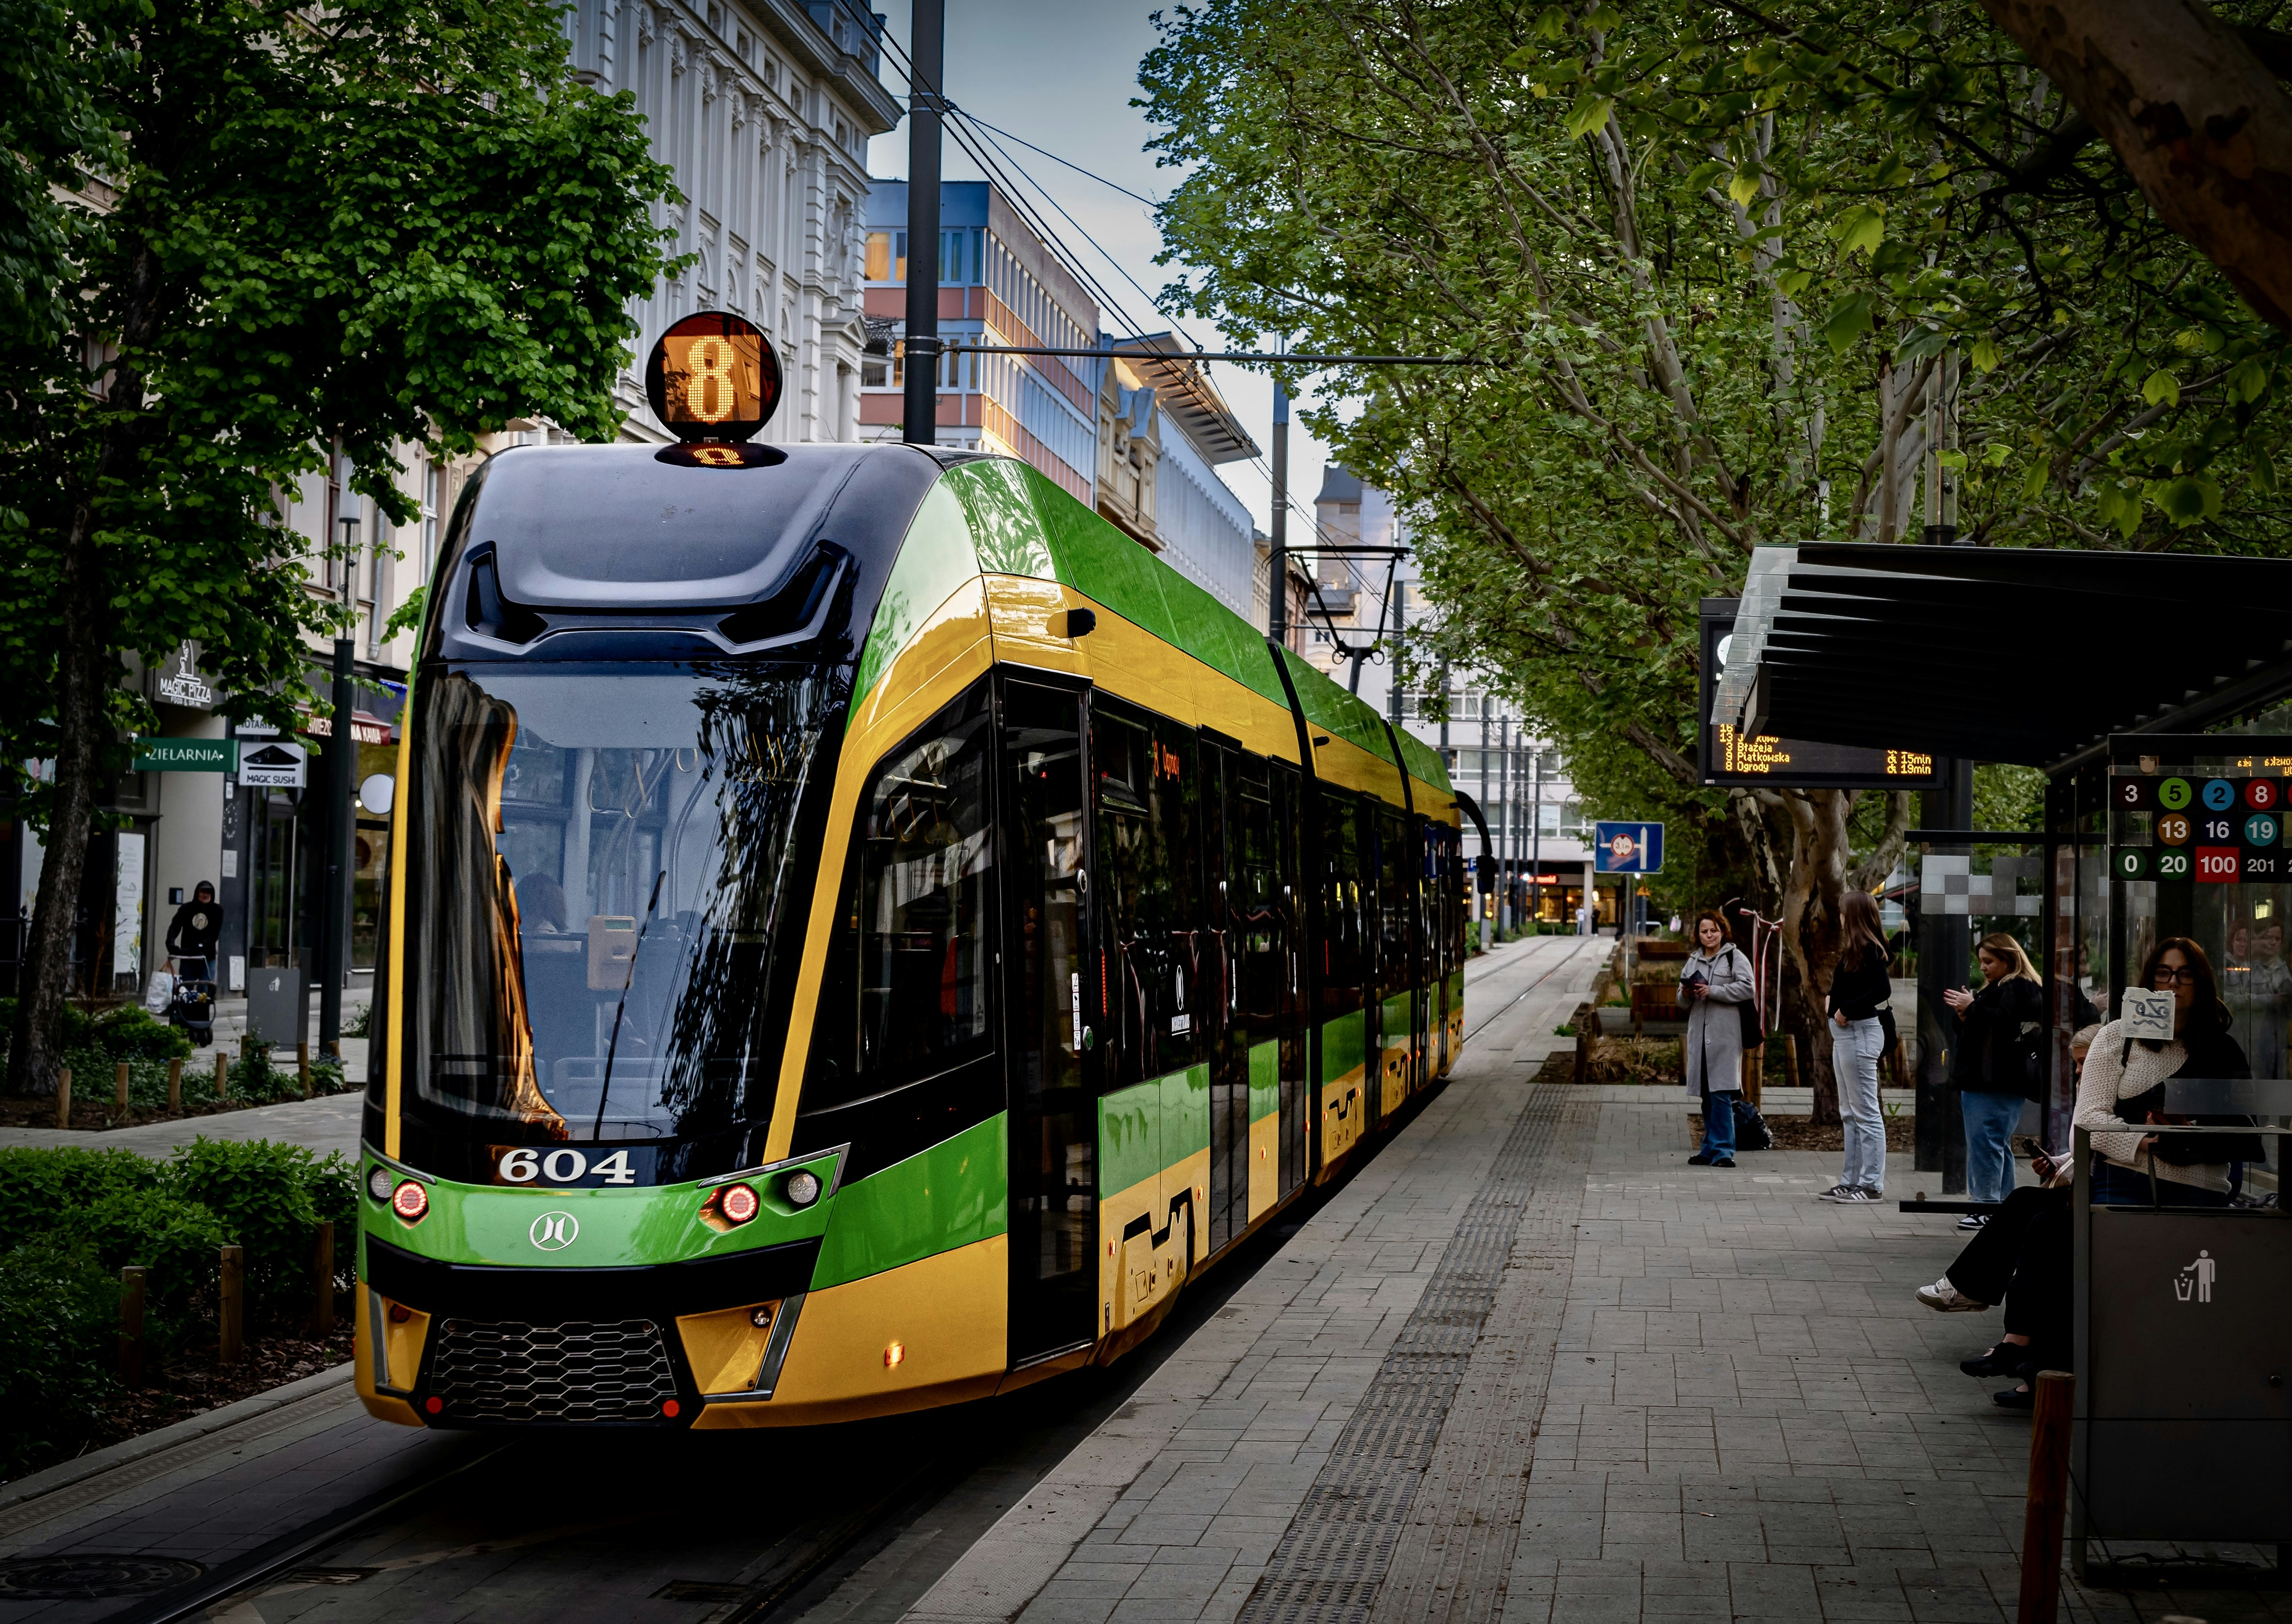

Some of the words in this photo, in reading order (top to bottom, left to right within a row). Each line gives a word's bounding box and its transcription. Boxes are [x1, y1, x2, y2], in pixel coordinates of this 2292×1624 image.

[688, 335, 735, 423] 8
[160, 677, 186, 696] MAGIC
[188, 682, 212, 702] PIZZA
[362, 726, 381, 744] KAWA
[1720, 723, 1733, 733] 16
[1720, 732, 1733, 742] 13
[149, 748, 220, 761] ZIELARNIA
[1726, 742, 1733, 752] 3
[1737, 742, 1773, 753] Błażeja
[1154, 739, 1159, 778] 8
[1162, 743, 1180, 783] Ogrody
[1726, 752, 1733, 761] 9
[1737, 751, 1790, 762] Piątkowska
[1901, 754, 1931, 764] 15min
[1726, 761, 1732, 771] 8
[1737, 761, 1769, 773] Ogrody
[1901, 764, 1931, 774] 19min
[247, 775, 271, 784] MAGIC
[273, 776, 296, 785] SUSHI
[2125, 785, 2138, 802] 3
[2168, 785, 2182, 802] 5
[2212, 786, 2226, 804] 2
[2255, 786, 2268, 803] 8
[2161, 821, 2187, 838] 13
[2205, 821, 2230, 839] 16
[2248, 821, 2274, 839] 19
[2124, 855, 2138, 873] 0
[2161, 855, 2187, 873] 20
[2200, 856, 2237, 874] 100
[2247, 859, 2274, 873] 201
[499, 1148, 636, 1184] 604
